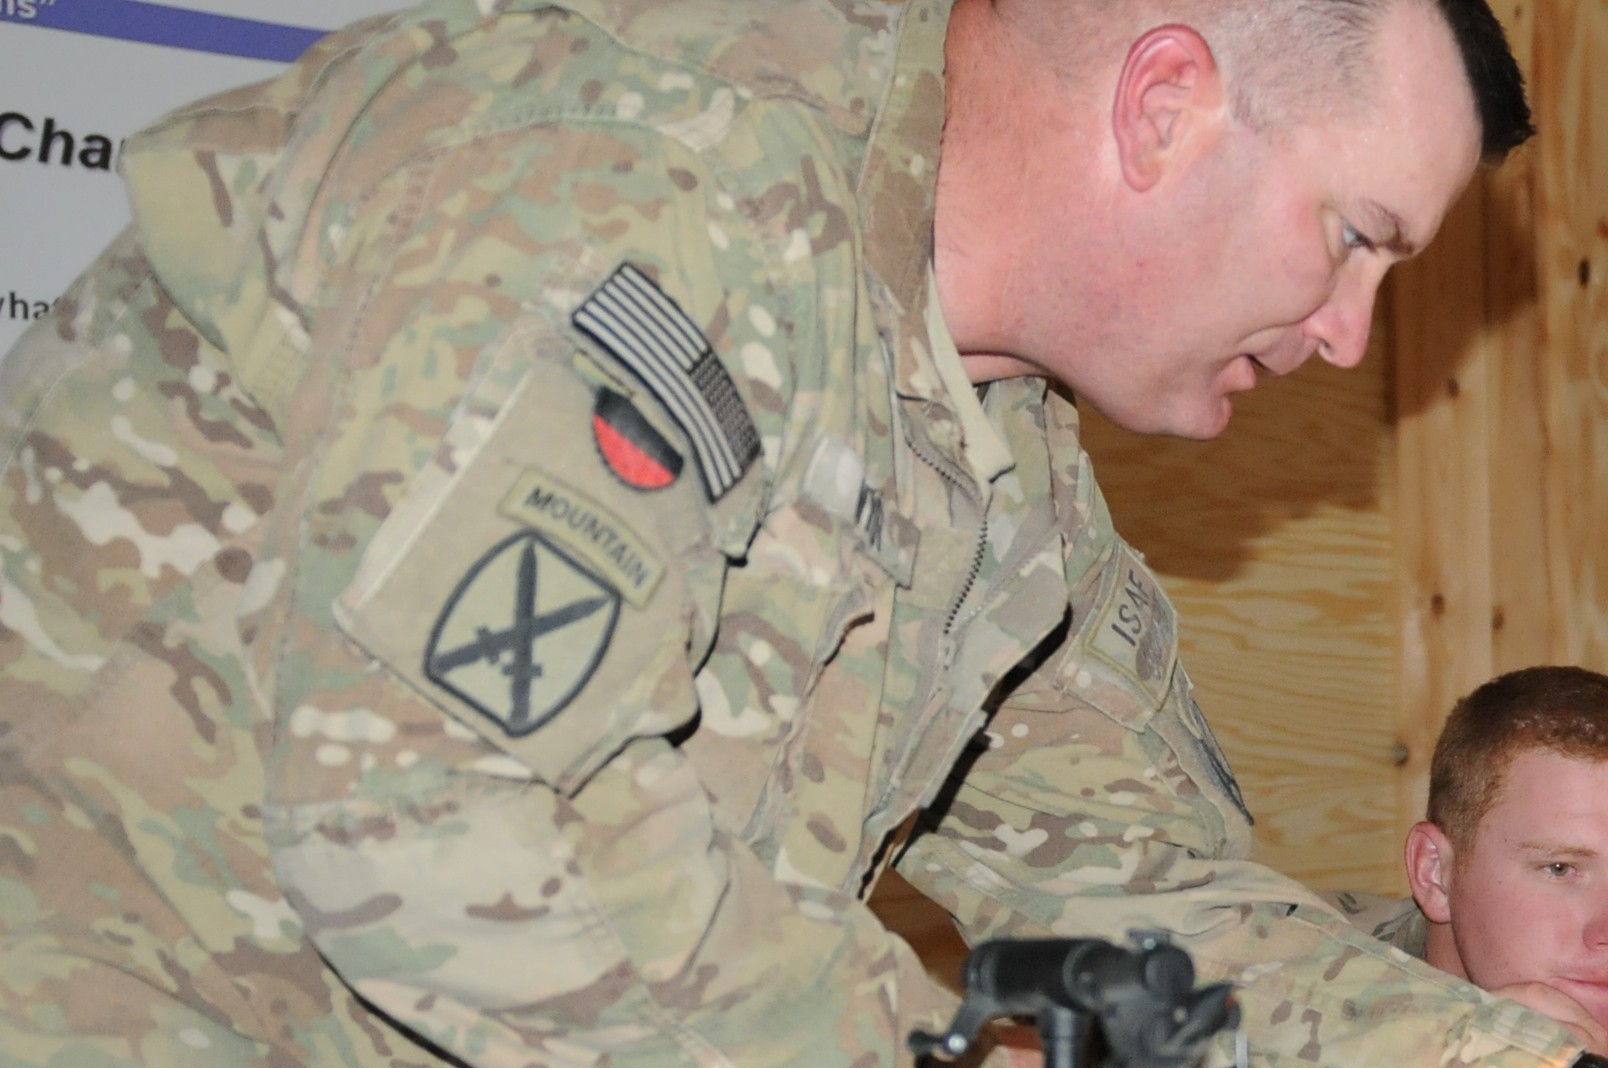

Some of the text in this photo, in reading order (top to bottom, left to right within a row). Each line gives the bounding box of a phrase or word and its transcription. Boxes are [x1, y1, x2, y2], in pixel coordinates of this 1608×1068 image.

[0, 112, 126, 171] Cha
[523, 486, 648, 588] MOUNTAIN
[1111, 569, 1150, 646] ISAF
